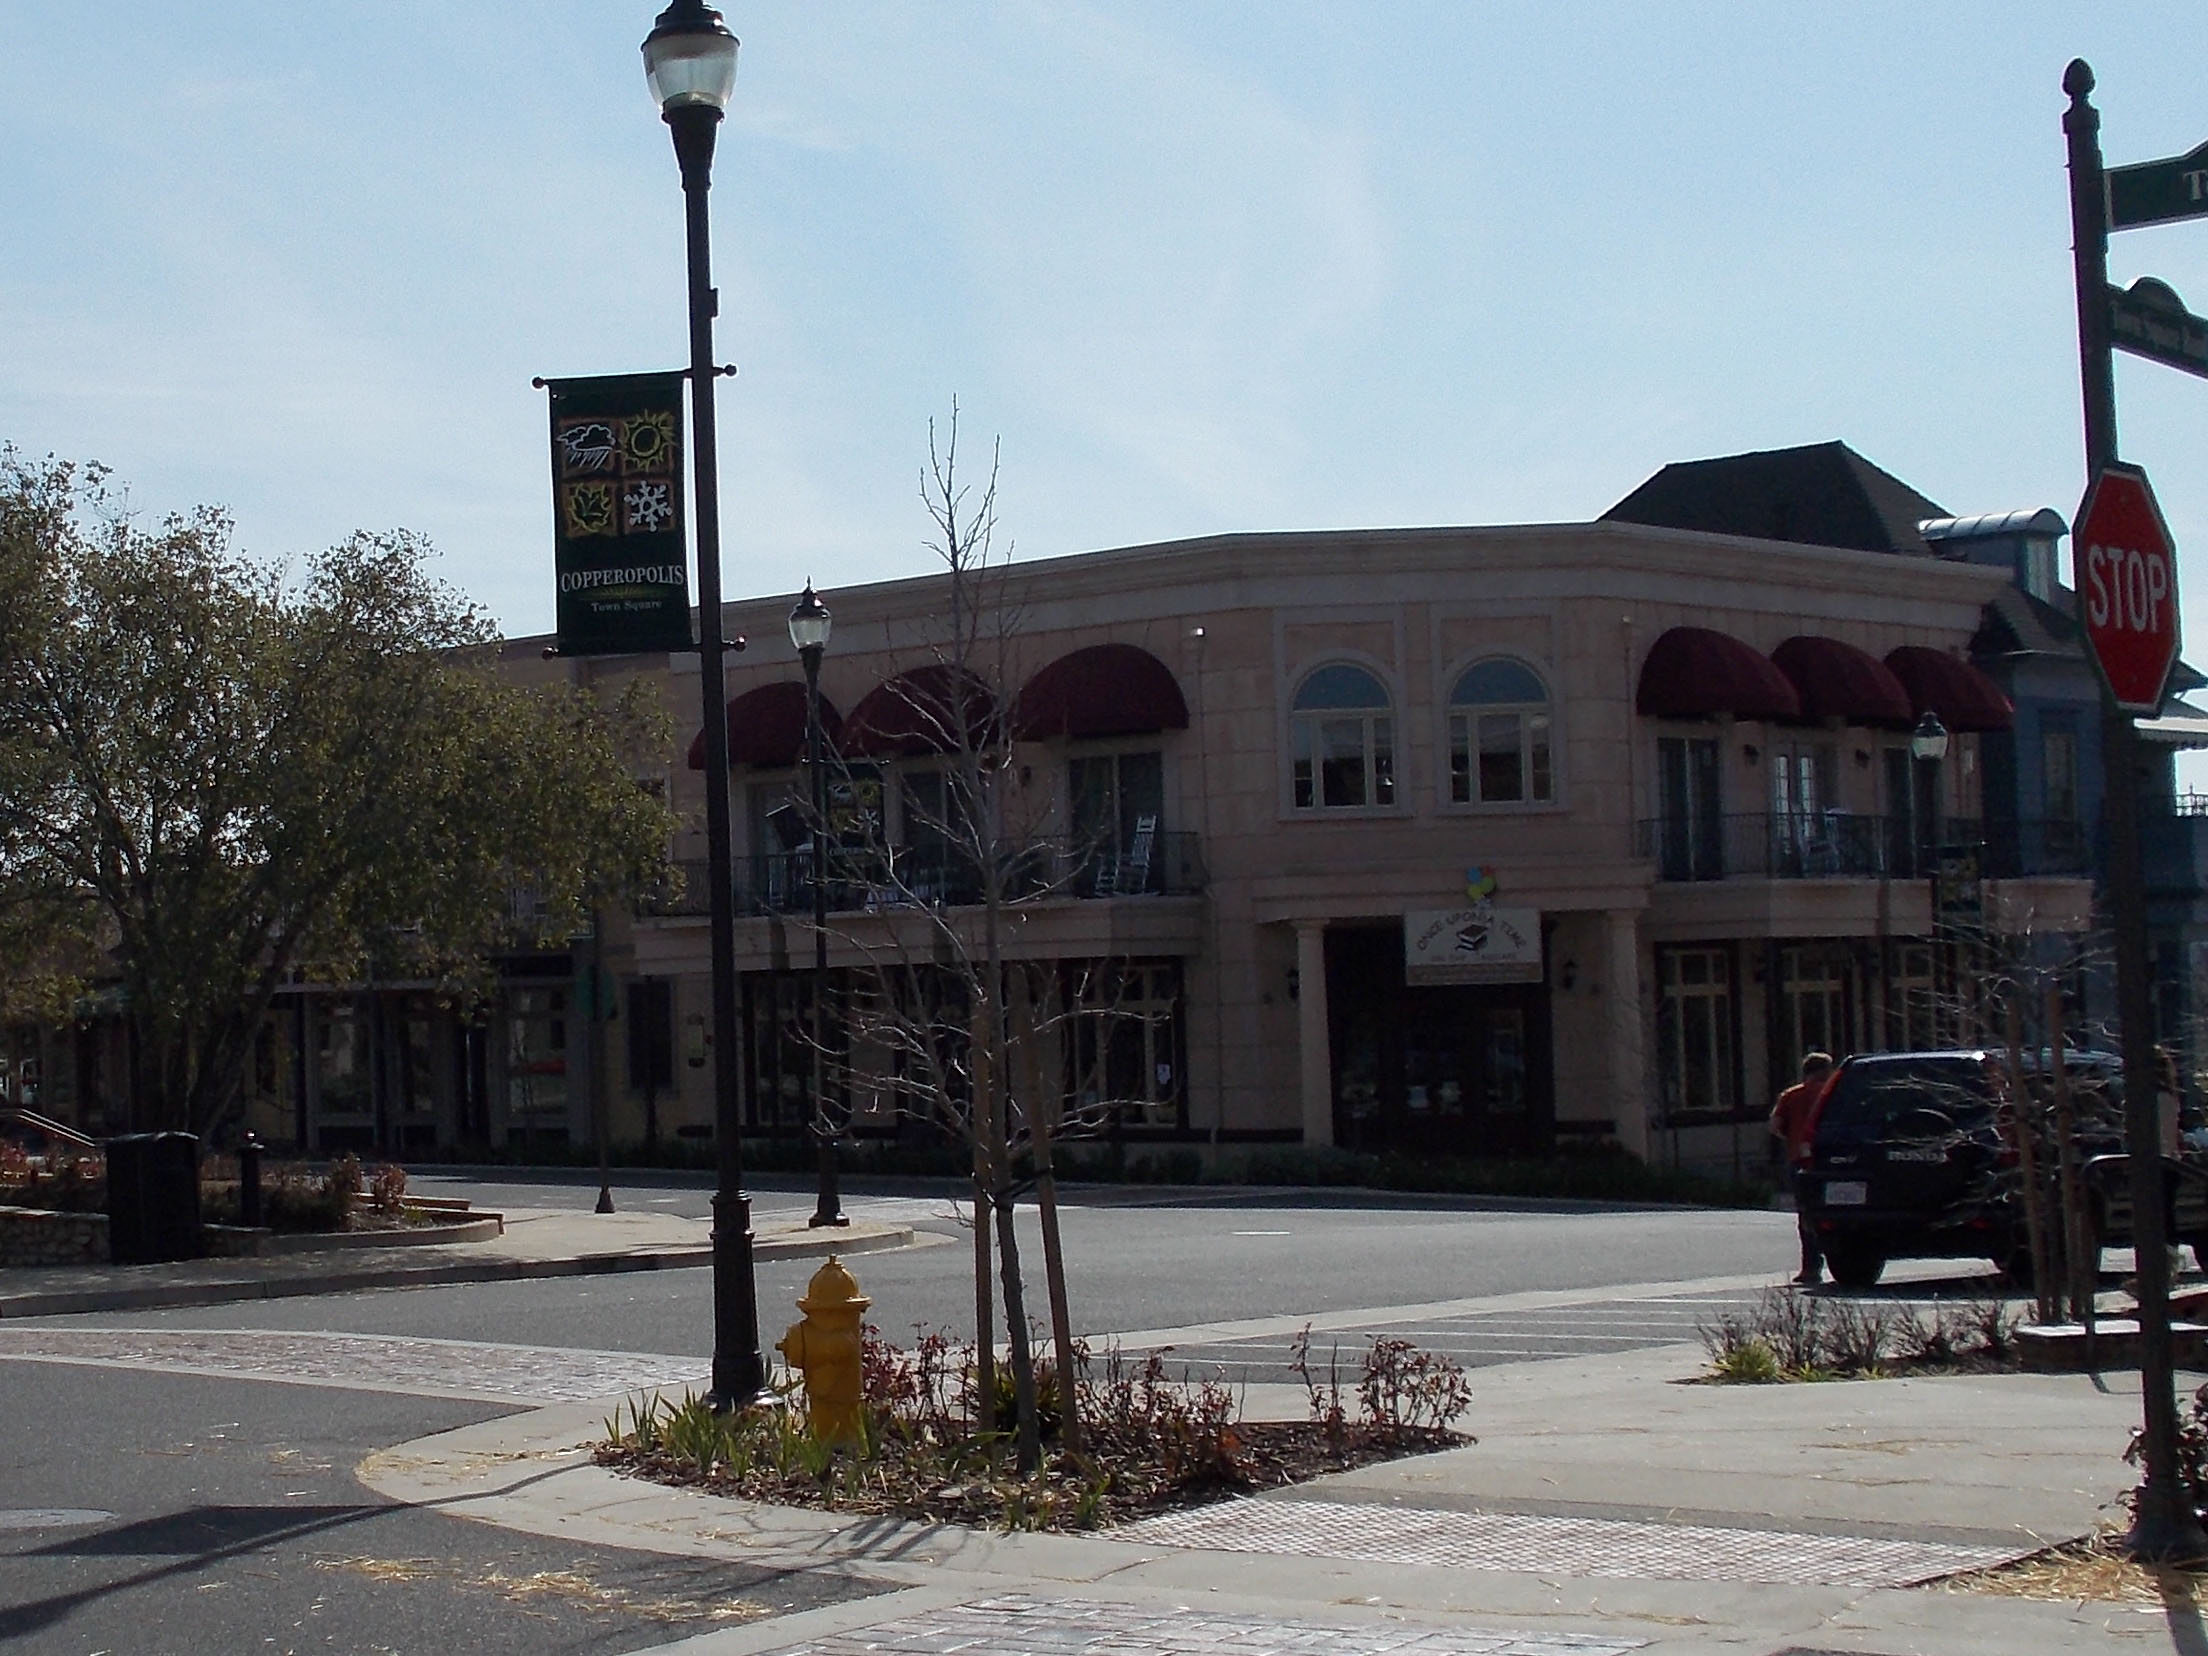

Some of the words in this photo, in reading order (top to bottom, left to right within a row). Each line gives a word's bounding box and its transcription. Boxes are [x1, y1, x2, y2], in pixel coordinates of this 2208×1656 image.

[2182, 168, 2208, 201] T
[561, 565, 685, 593] COPPEROPOLIS
[2087, 544, 2167, 633] STOP
[591, 602, 620, 612] Town
[624, 600, 662, 612] Square
